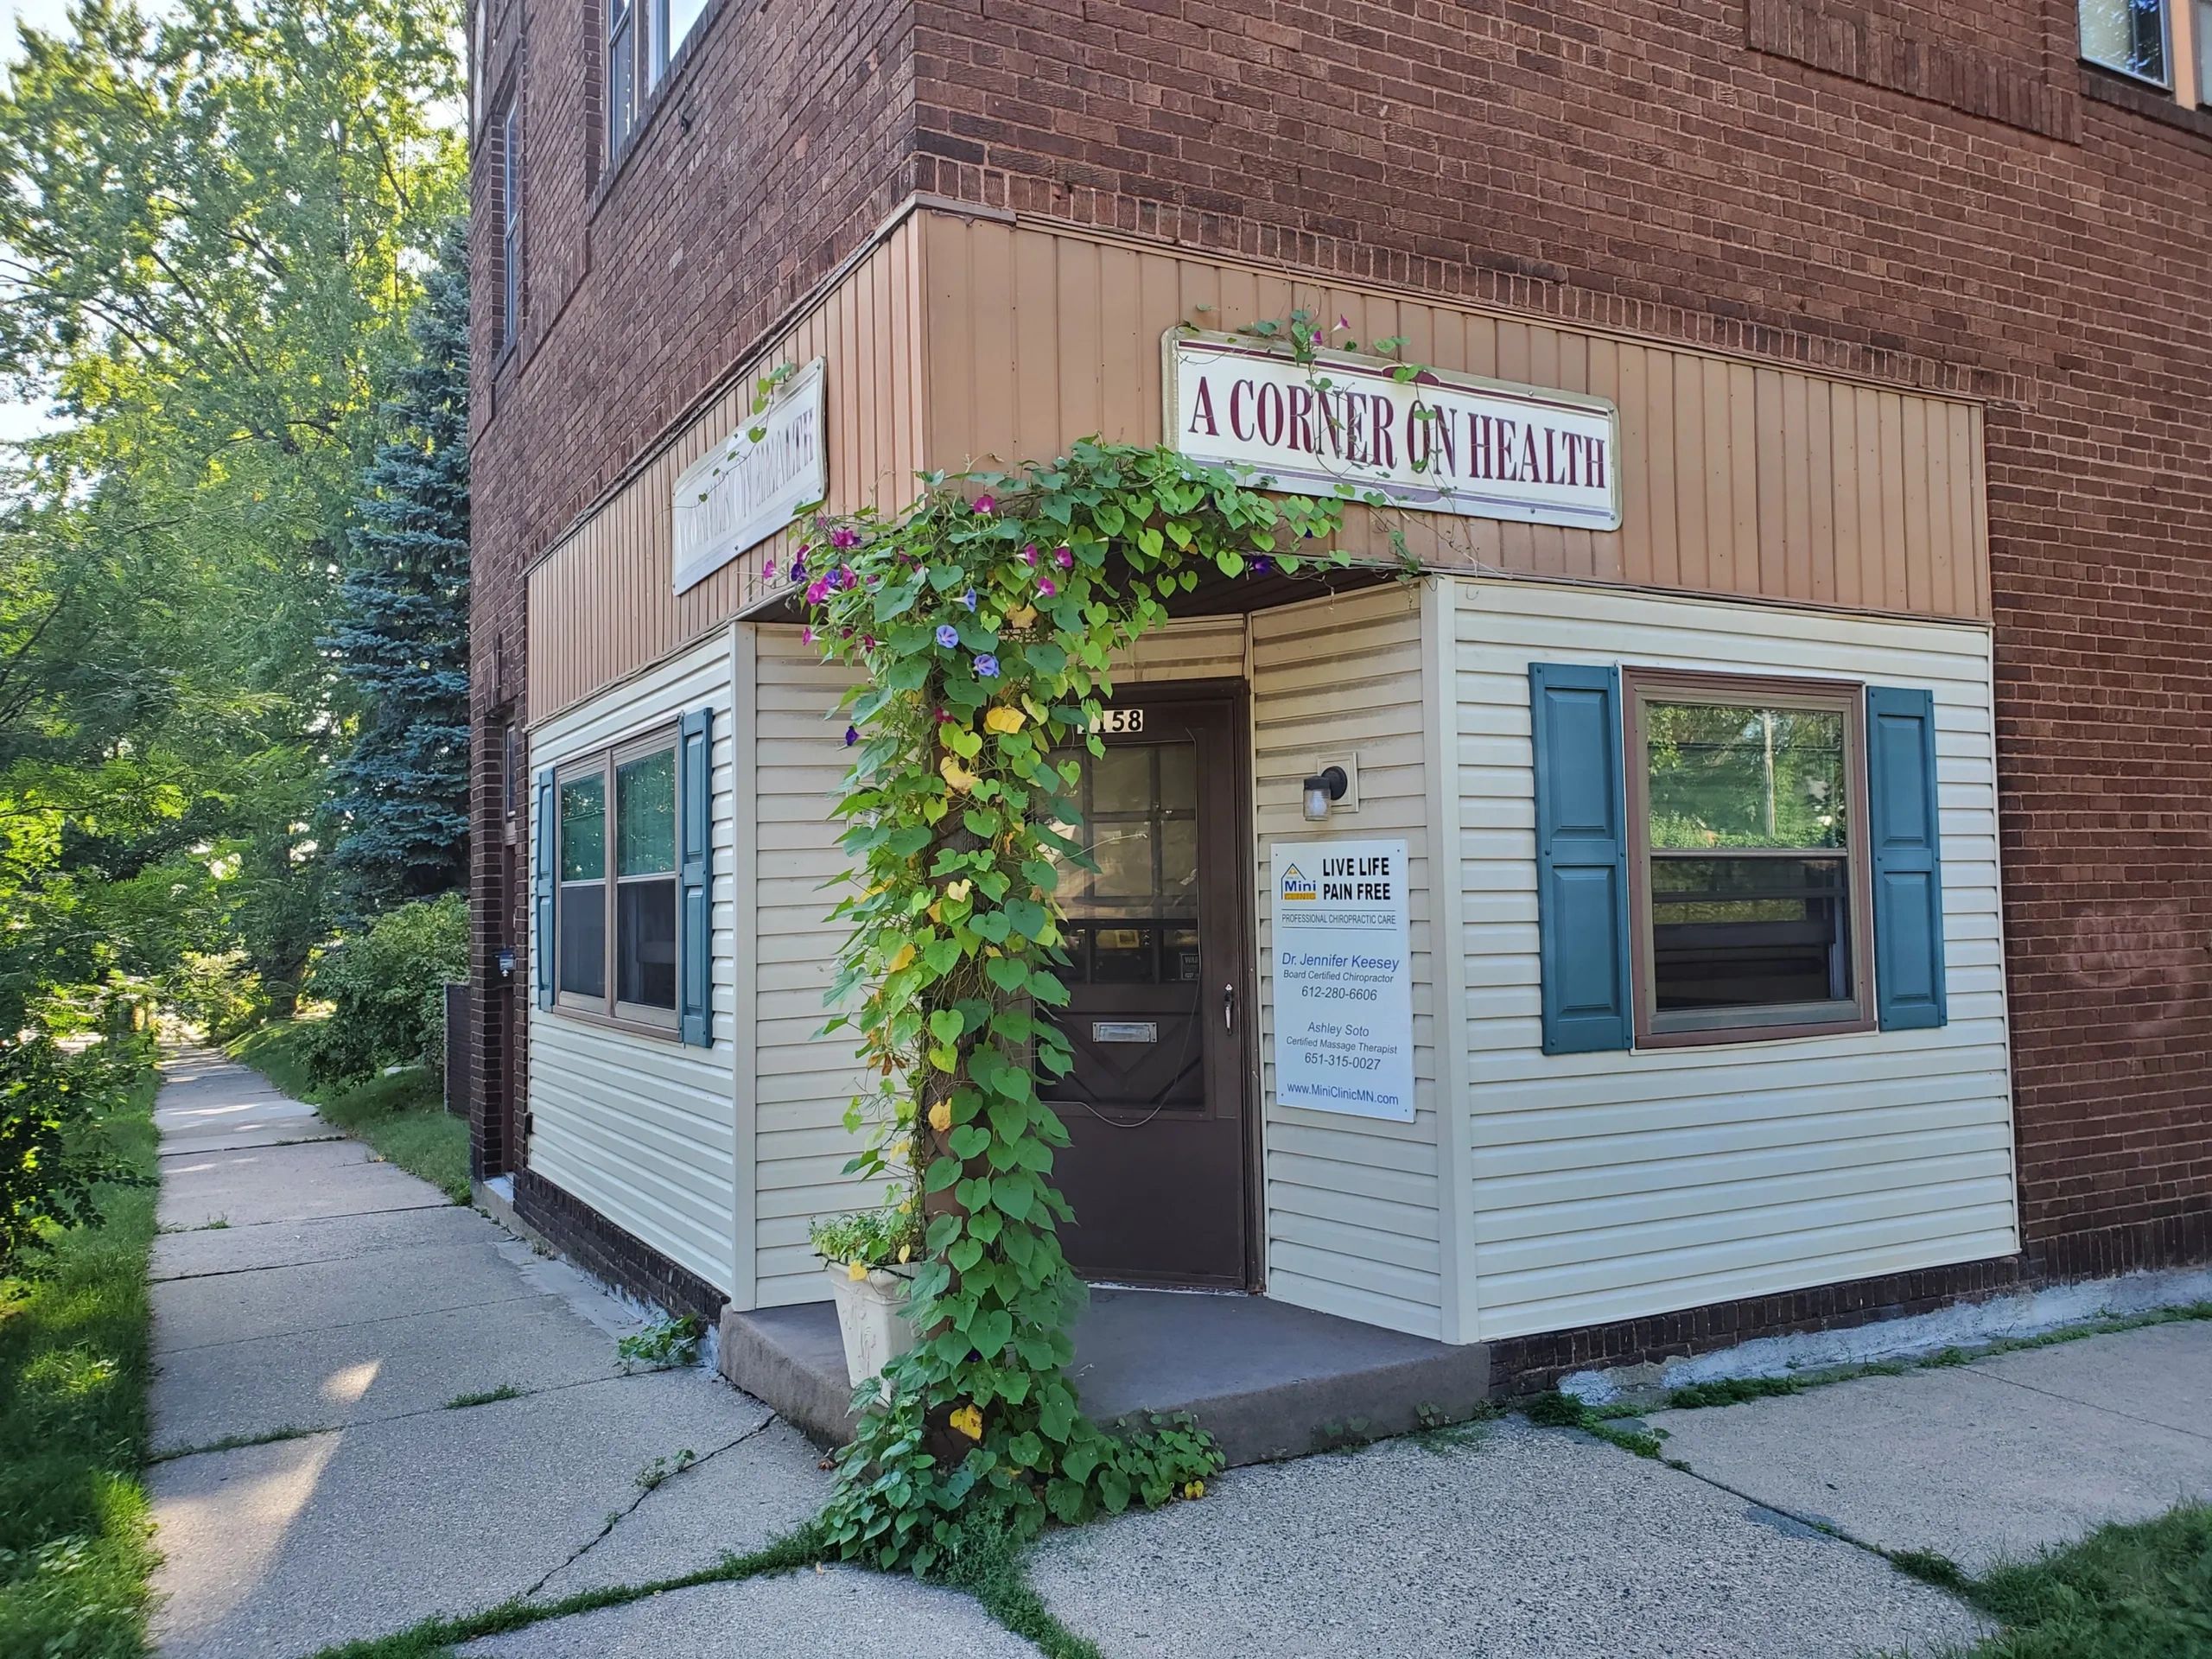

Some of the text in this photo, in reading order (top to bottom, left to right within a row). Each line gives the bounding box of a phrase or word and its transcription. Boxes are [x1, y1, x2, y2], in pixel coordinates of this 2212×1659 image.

[1187, 376, 1606, 489] A CORNER ON HEALTH
[1081, 709, 1141, 733] 158
[1323, 857, 1389, 876] LIVE LIFE
[1285, 880, 1316, 892] Mini
[1323, 883, 1391, 900] PAIN FREE
[1282, 913, 1396, 925] PROFESSIONAL CHIROPRACTIC CARE
[1282, 952, 1400, 972] Dr. Jennifer Keesey
[1283, 969, 1394, 983] Board Certified Chiropractor
[1301, 986, 1377, 1001] 612-280-6606
[1307, 1021, 1370, 1037] Ashley Soto
[1286, 1036, 1398, 1054] Certified Massage Therapist
[1305, 1052, 1381, 1071] 651-315-0027
[1287, 1083, 1399, 1105] www.MiniClinicMN.com
